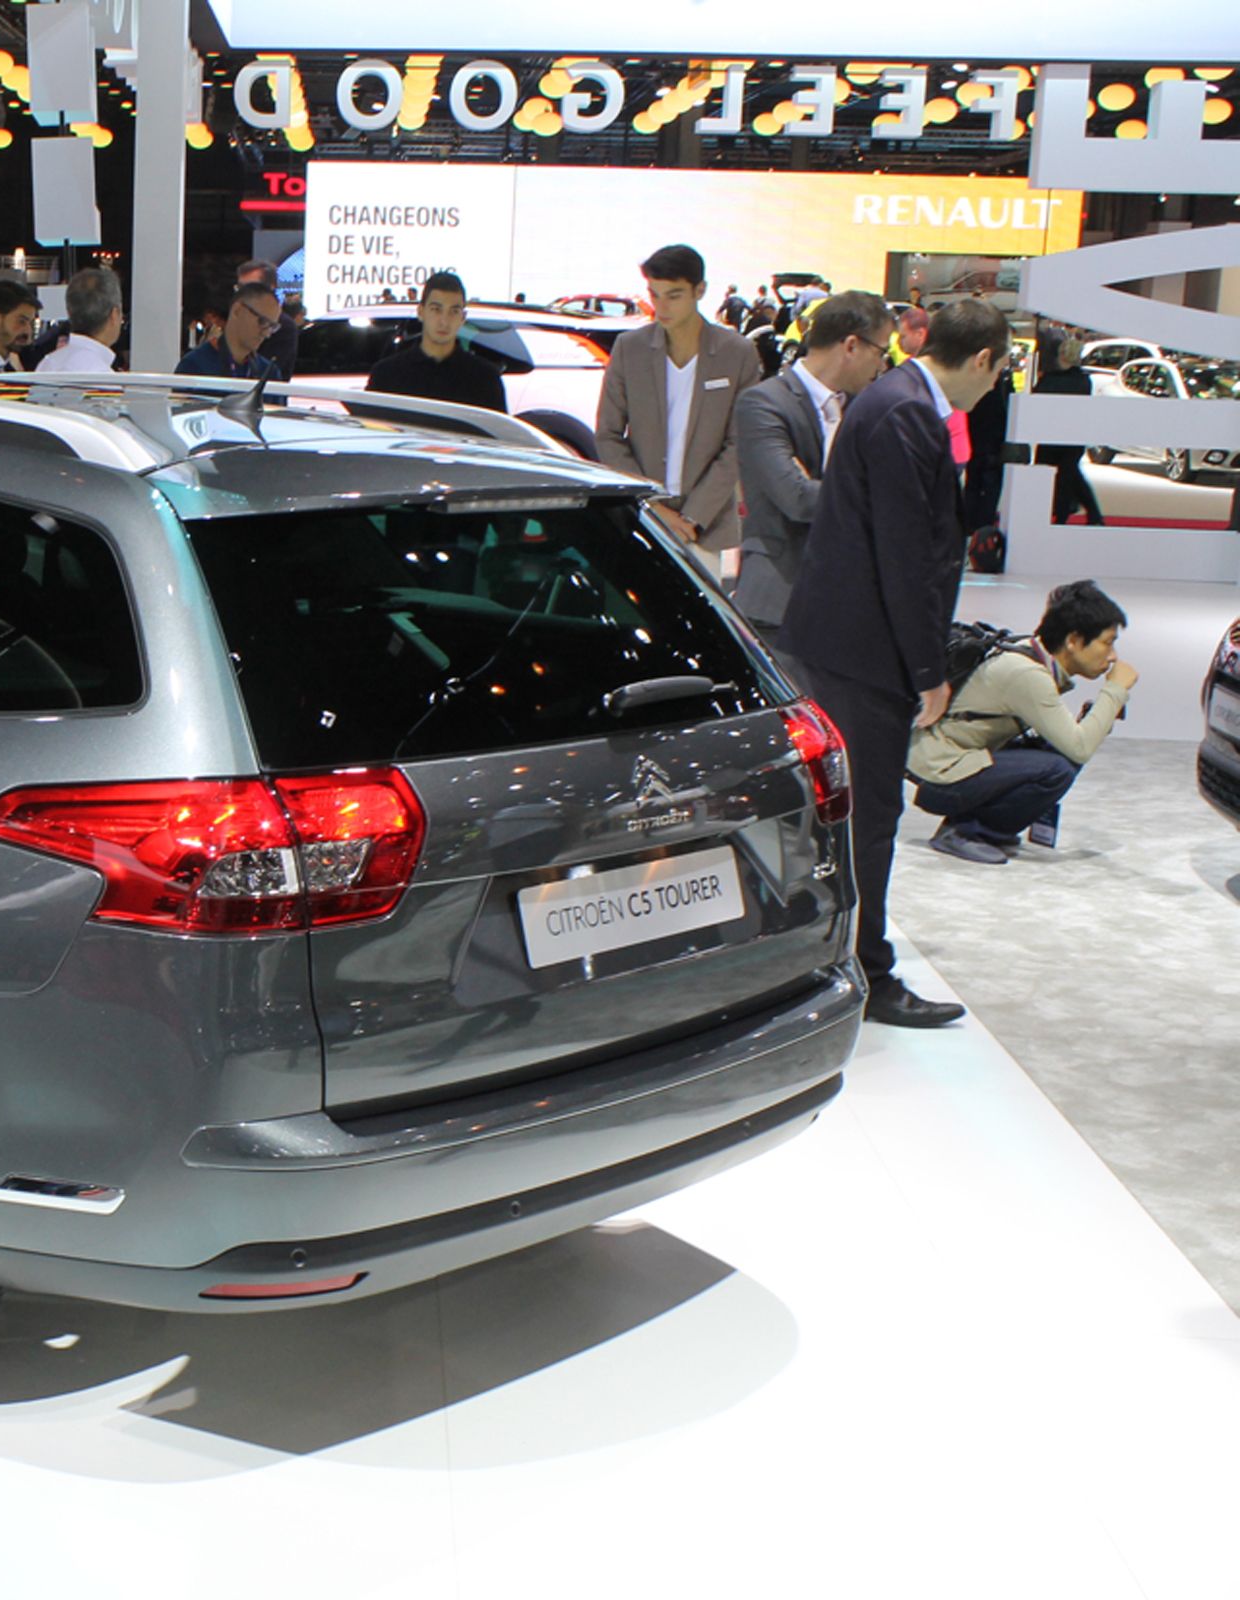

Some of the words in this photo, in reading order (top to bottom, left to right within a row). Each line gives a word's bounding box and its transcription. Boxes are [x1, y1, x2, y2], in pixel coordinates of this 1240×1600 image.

[328, 204, 460, 228] CHANGEONS
[852, 194, 1063, 230] RENAULT
[328, 234, 355, 255] DE
[361, 235, 400, 259] VIE,
[546, 896, 624, 937] CITROËN
[627, 891, 653, 918] C5
[655, 874, 723, 912] TOURER
